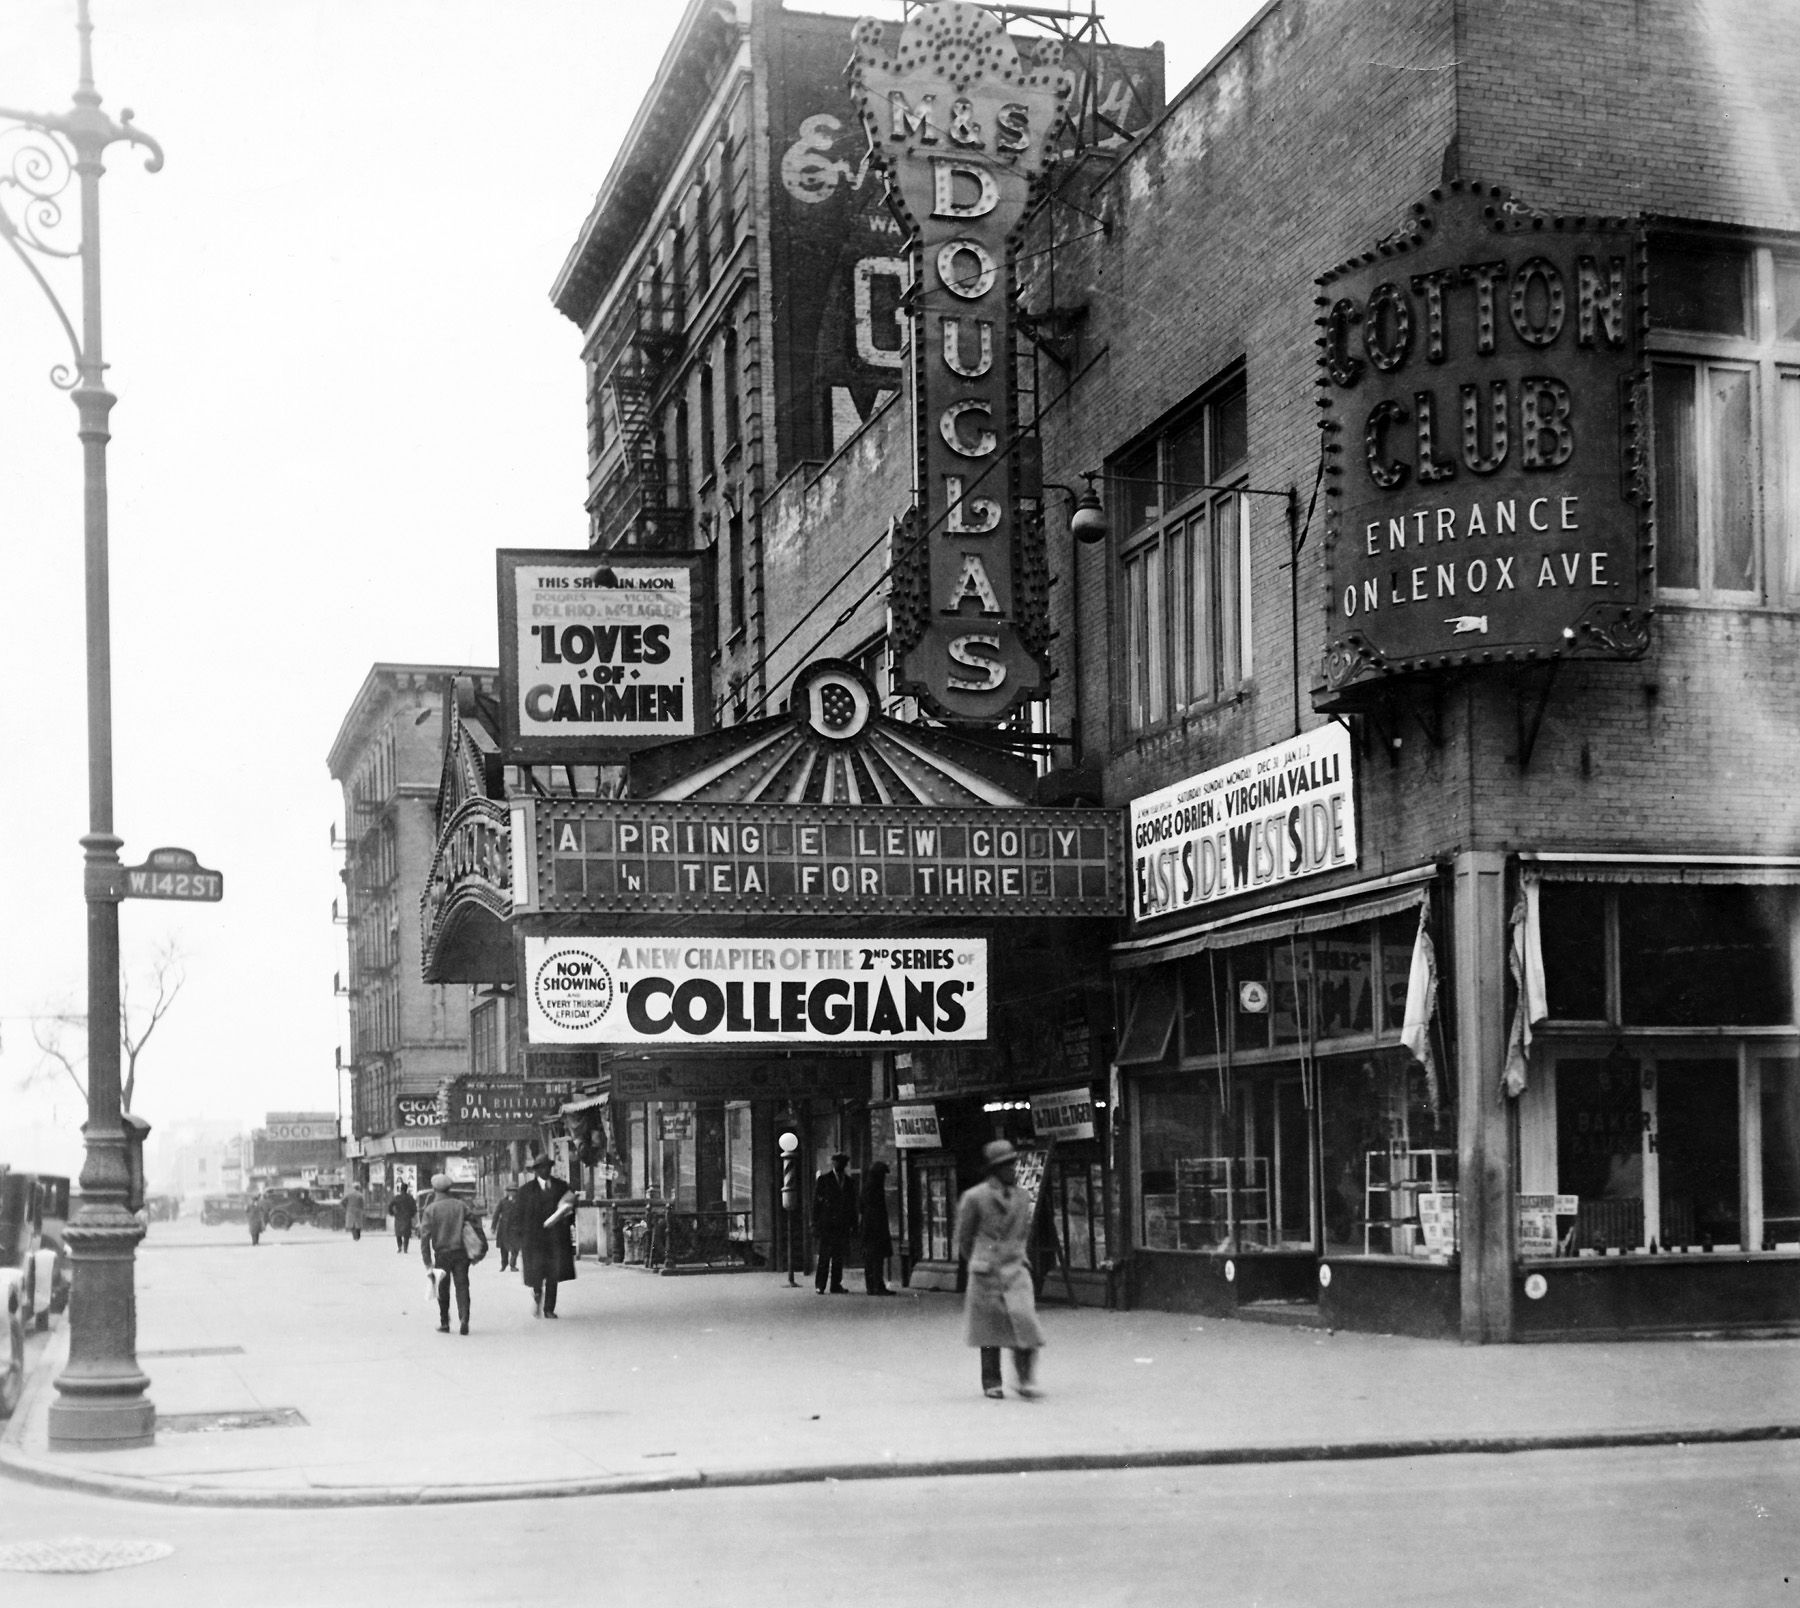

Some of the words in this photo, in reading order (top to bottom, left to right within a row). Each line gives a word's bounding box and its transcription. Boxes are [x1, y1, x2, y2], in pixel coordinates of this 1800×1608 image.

[1327, 255, 1626, 389] COTTON
[930, 156, 1006, 691] DOUGLAS
[1365, 376, 1574, 489] CLUB
[1366, 497, 1579, 556] ENTRANCE
[538, 577, 569, 588] THIS
[1344, 577, 1379, 617] ON
[1392, 556, 1514, 605] LENOX
[532, 603, 561, 617] DEL
[593, 665, 625, 684] OF
[808, 673, 870, 739] D
[1257, 758, 1271, 775] DEC
[1136, 813, 1173, 849] GEORGE
[1225, 773, 1287, 818] VIRGINIA
[1288, 753, 1340, 798] VALLI
[559, 824, 578, 851] A
[620, 824, 819, 855] PRINGLE
[858, 828, 936, 857] LEW
[973, 830, 1075, 857] CODY
[1136, 847, 1179, 917] EAST
[1182, 832, 1227, 905] SIDE
[1229, 812, 1286, 890] WEST
[1288, 792, 1347, 876] SIDE
[683, 864, 763, 893] TEA
[802, 866, 879, 895] FOR
[918, 867, 1048, 896] THREE
[557, 962, 593, 976] NOW
[617, 948, 634, 969] A
[636, 948, 681, 969] NEW
[684, 948, 776, 970] CHAPTER
[779, 948, 811, 970] OF
[815, 949, 854, 970] THE
[890, 949, 954, 970] SERIES
[957, 953, 975, 966] OF
[543, 977, 606, 990] SHOWING
[547, 1000, 570, 1008] EVERY
[561, 1010, 590, 1018] FRIDAY
